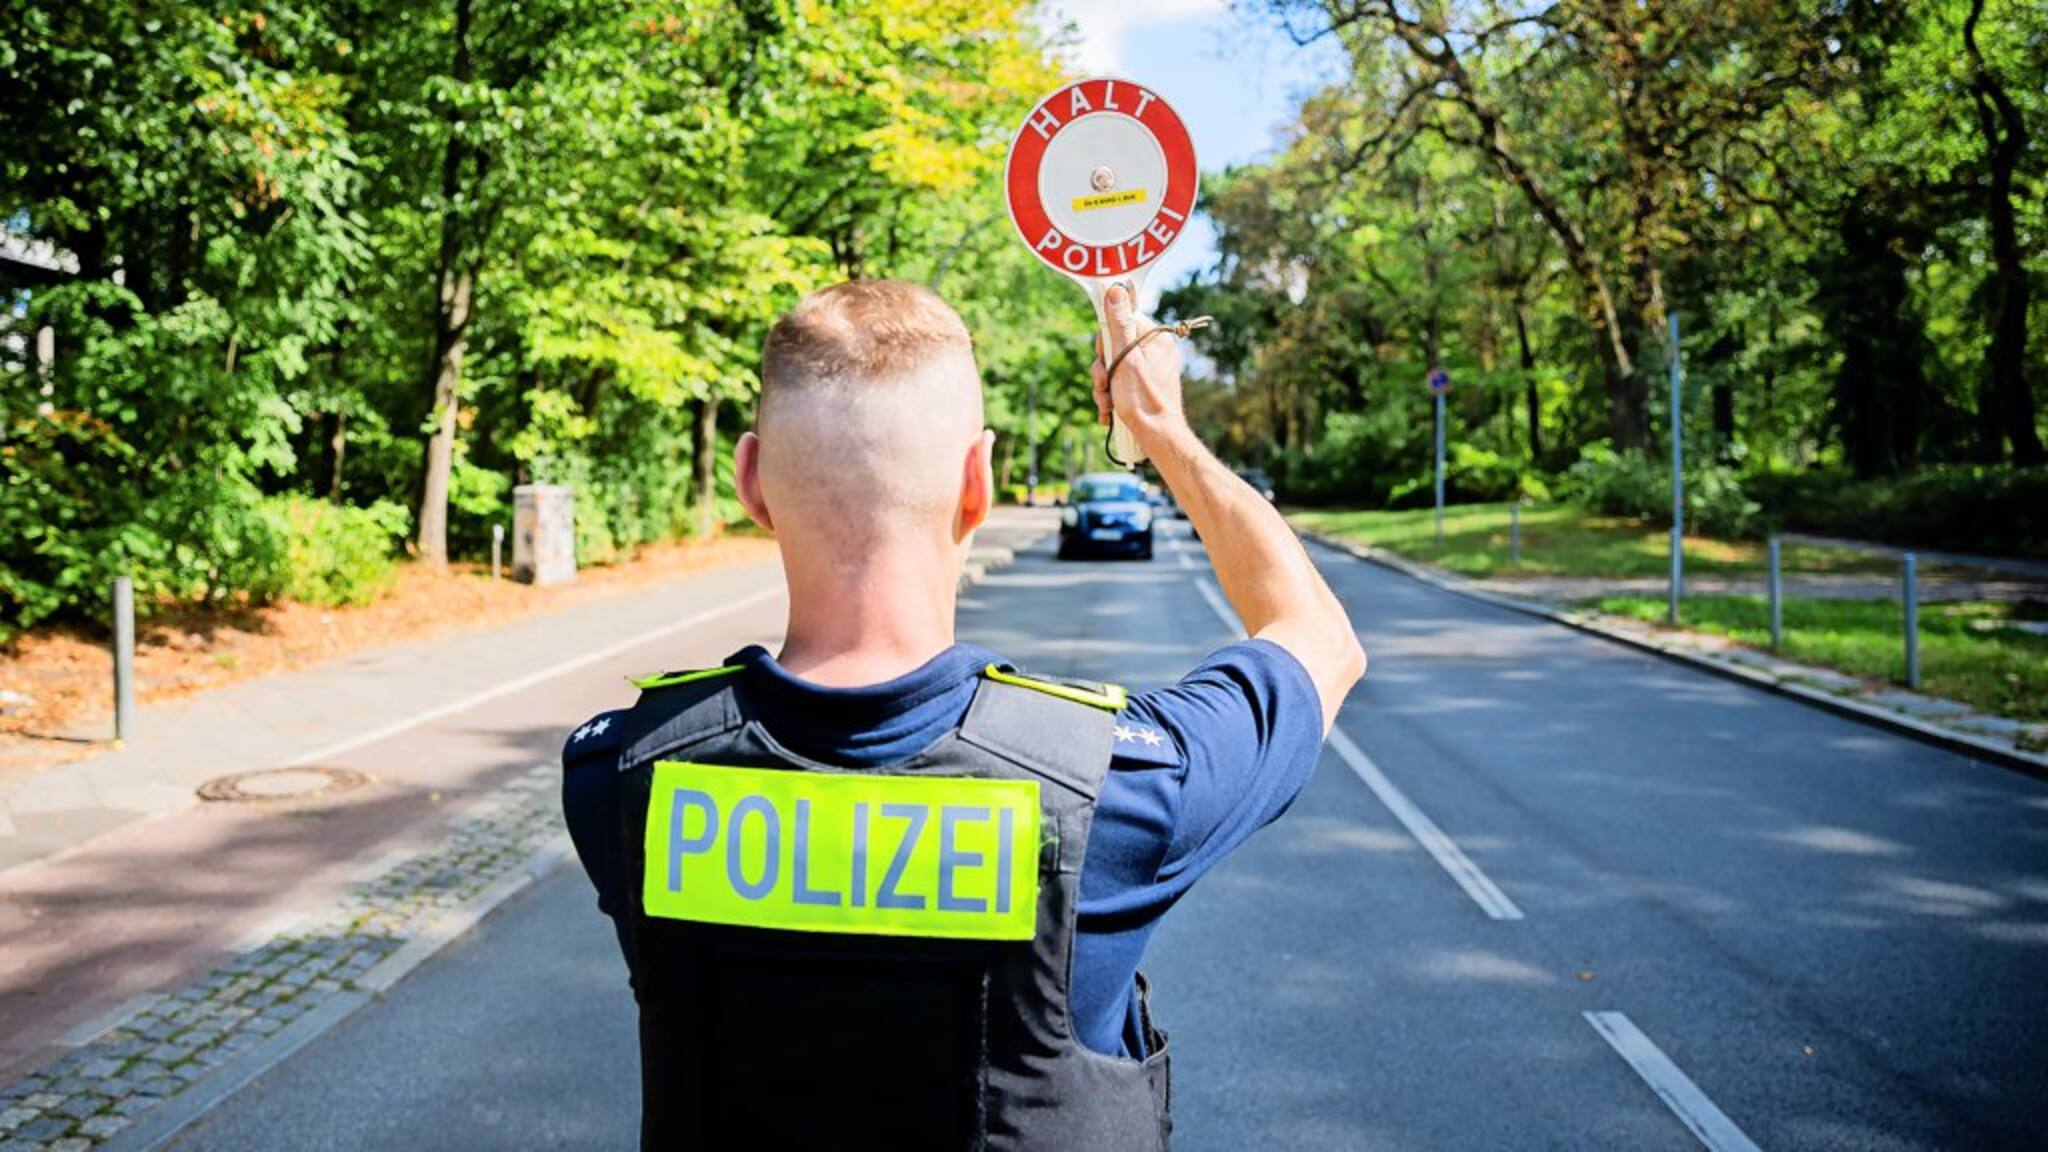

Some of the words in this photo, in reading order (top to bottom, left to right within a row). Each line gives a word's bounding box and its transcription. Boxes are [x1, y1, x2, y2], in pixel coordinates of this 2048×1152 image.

[1029, 82, 1155, 139] HALT
[1036, 207, 1184, 275] POLIZEI
[668, 789, 1013, 913] POLIZEI
